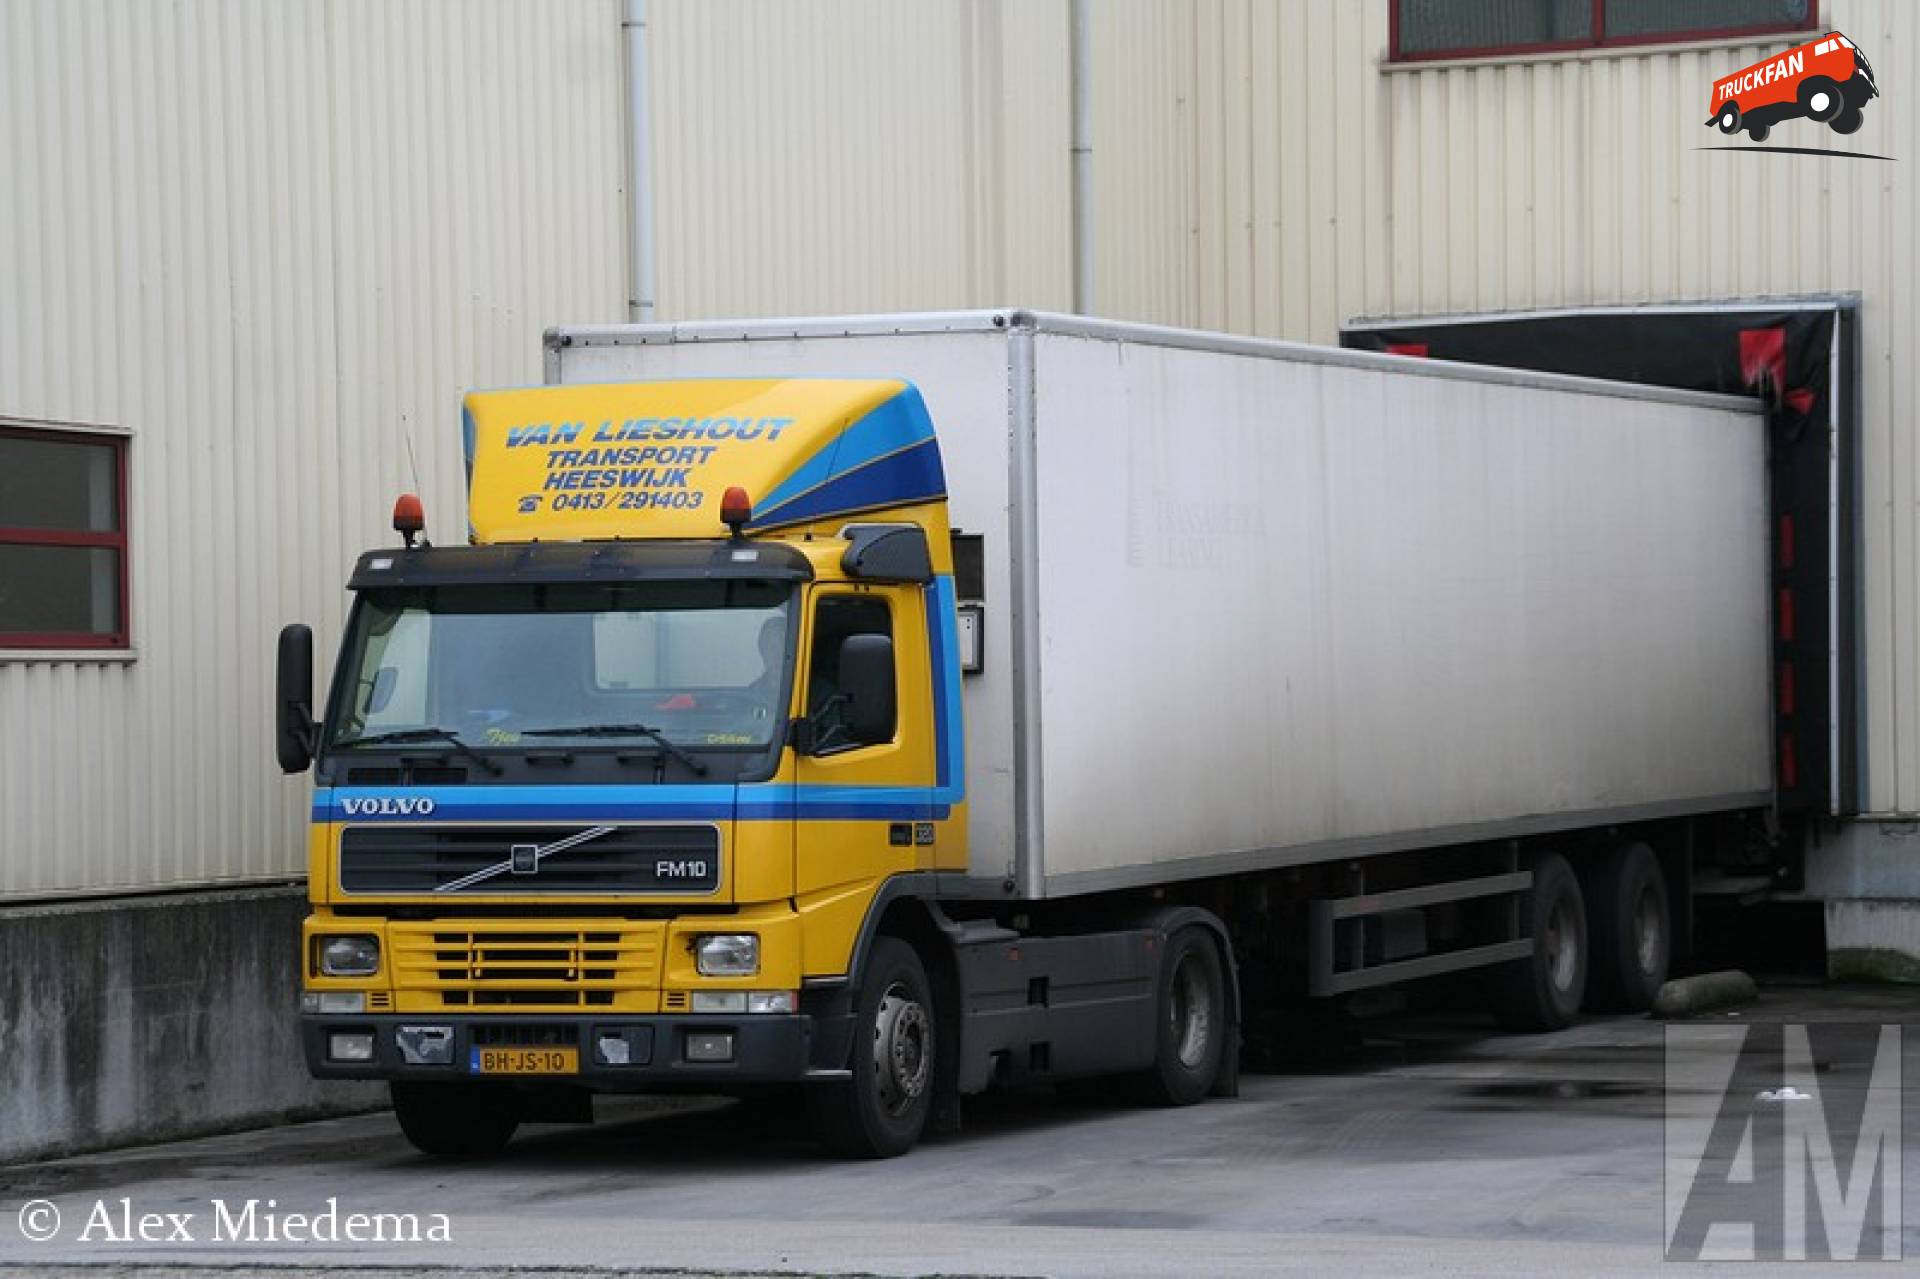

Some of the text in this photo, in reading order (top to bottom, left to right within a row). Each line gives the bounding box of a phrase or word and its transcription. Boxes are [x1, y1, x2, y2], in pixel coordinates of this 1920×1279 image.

[506, 416, 794, 448] VAN LIESHOUT
[545, 445, 717, 469] TRANSPORT
[543, 467, 690, 491] HEESWIJK
[550, 492, 704, 513] 0413/291403
[340, 797, 435, 815] VOLVO
[655, 860, 707, 878] FM10
[484, 1052, 566, 1071] BH-JS-10
